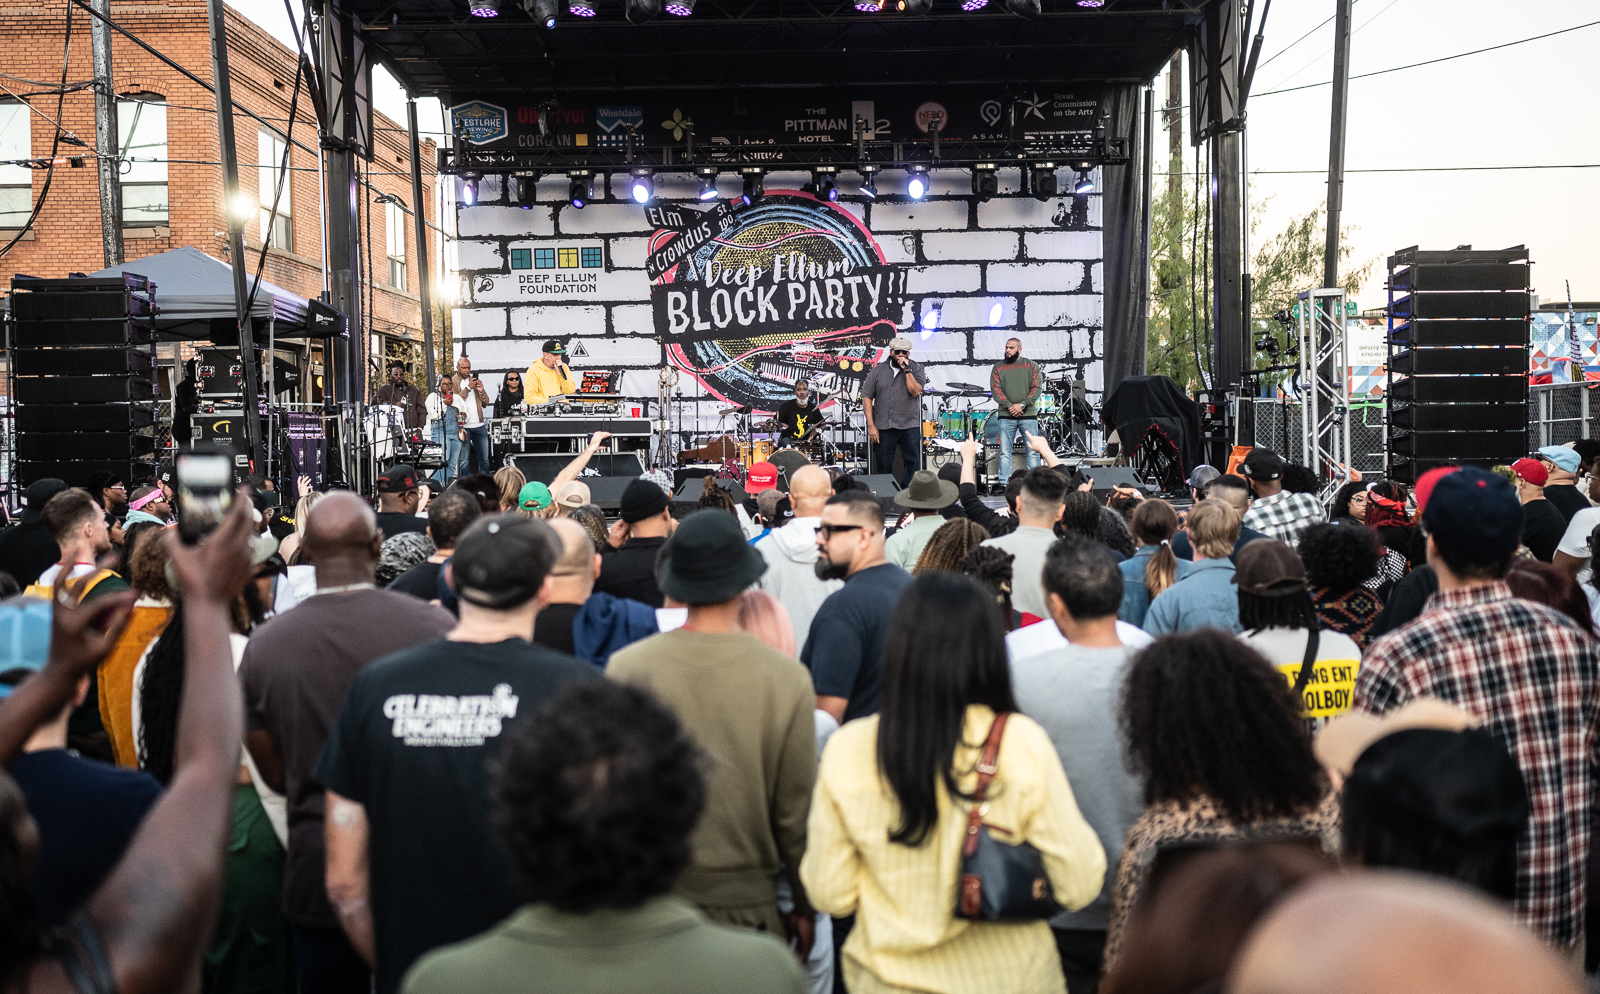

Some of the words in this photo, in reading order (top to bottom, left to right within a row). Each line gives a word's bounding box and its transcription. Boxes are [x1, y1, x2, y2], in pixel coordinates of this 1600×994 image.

[1054, 100, 1097, 108] Commission
[517, 105, 587, 124] Obrver
[600, 108, 642, 117] Westdale
[1078, 108, 1094, 116] Arts
[785, 118, 848, 131] PITTMAN
[798, 135, 834, 143] HOTEL
[971, 132, 1008, 141] ASAN
[649, 206, 683, 227] Elm
[718, 214, 734, 231] 100
[655, 221, 712, 272] Crowdus
[705, 258, 768, 291] Deep
[772, 252, 855, 284] Ellum
[518, 274, 550, 284] DEEP
[555, 273, 597, 282] ELLUM
[520, 284, 597, 294] FOUNDATION
[667, 283, 780, 335] BLOCK
